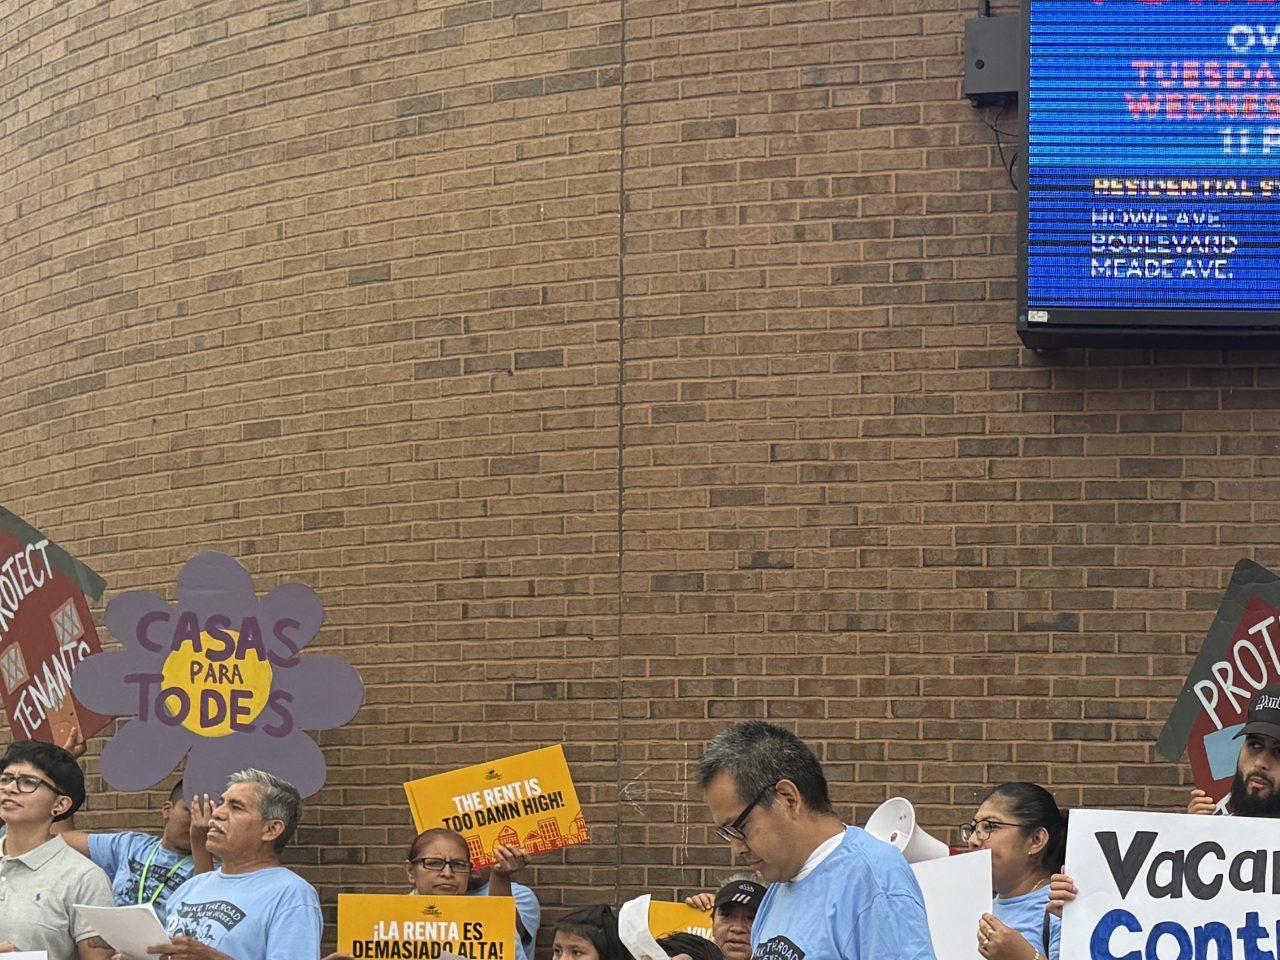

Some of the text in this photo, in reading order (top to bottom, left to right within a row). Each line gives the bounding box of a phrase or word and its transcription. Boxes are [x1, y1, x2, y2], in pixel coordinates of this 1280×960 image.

[1217, 126, 1250, 156] 11
[1093, 177, 1254, 196] RESIDENTIAL
[1091, 208, 1168, 228] HOWE
[1091, 232, 1239, 254] BOULEVARD
[1090, 257, 1175, 279] MEADE
[135, 610, 302, 668] CASAS
[189, 659, 245, 686] PARA
[123, 672, 295, 738] TODES
[451, 777, 543, 814] THE RENT IS
[441, 790, 566, 833] TOO DAMN HIGH!
[204, 902, 222, 911] THE
[219, 903, 241, 921] ROAD
[403, 920, 460, 941] RENTA
[463, 922, 484, 941] ES
[352, 940, 505, 960] DEMASIADO ALTA!
